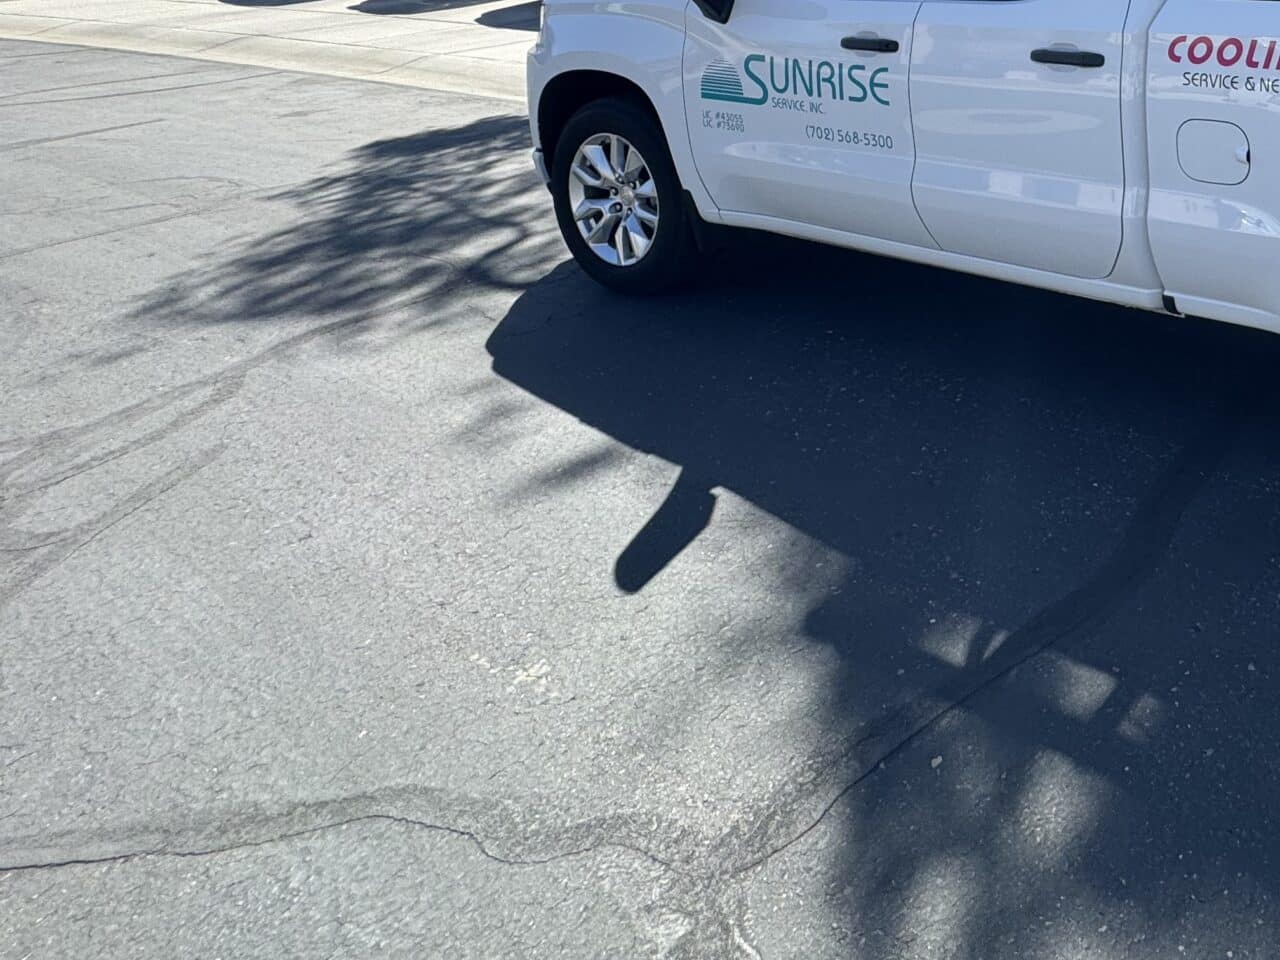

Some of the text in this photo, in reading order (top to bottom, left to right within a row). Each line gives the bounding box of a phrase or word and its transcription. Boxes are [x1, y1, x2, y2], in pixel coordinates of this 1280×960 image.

[743, 54, 890, 106] SUNRISE
[1182, 72, 1239, 90] SERVICE
[1244, 76, 1256, 92] &
[805, 125, 894, 149] (702) 568-5300
